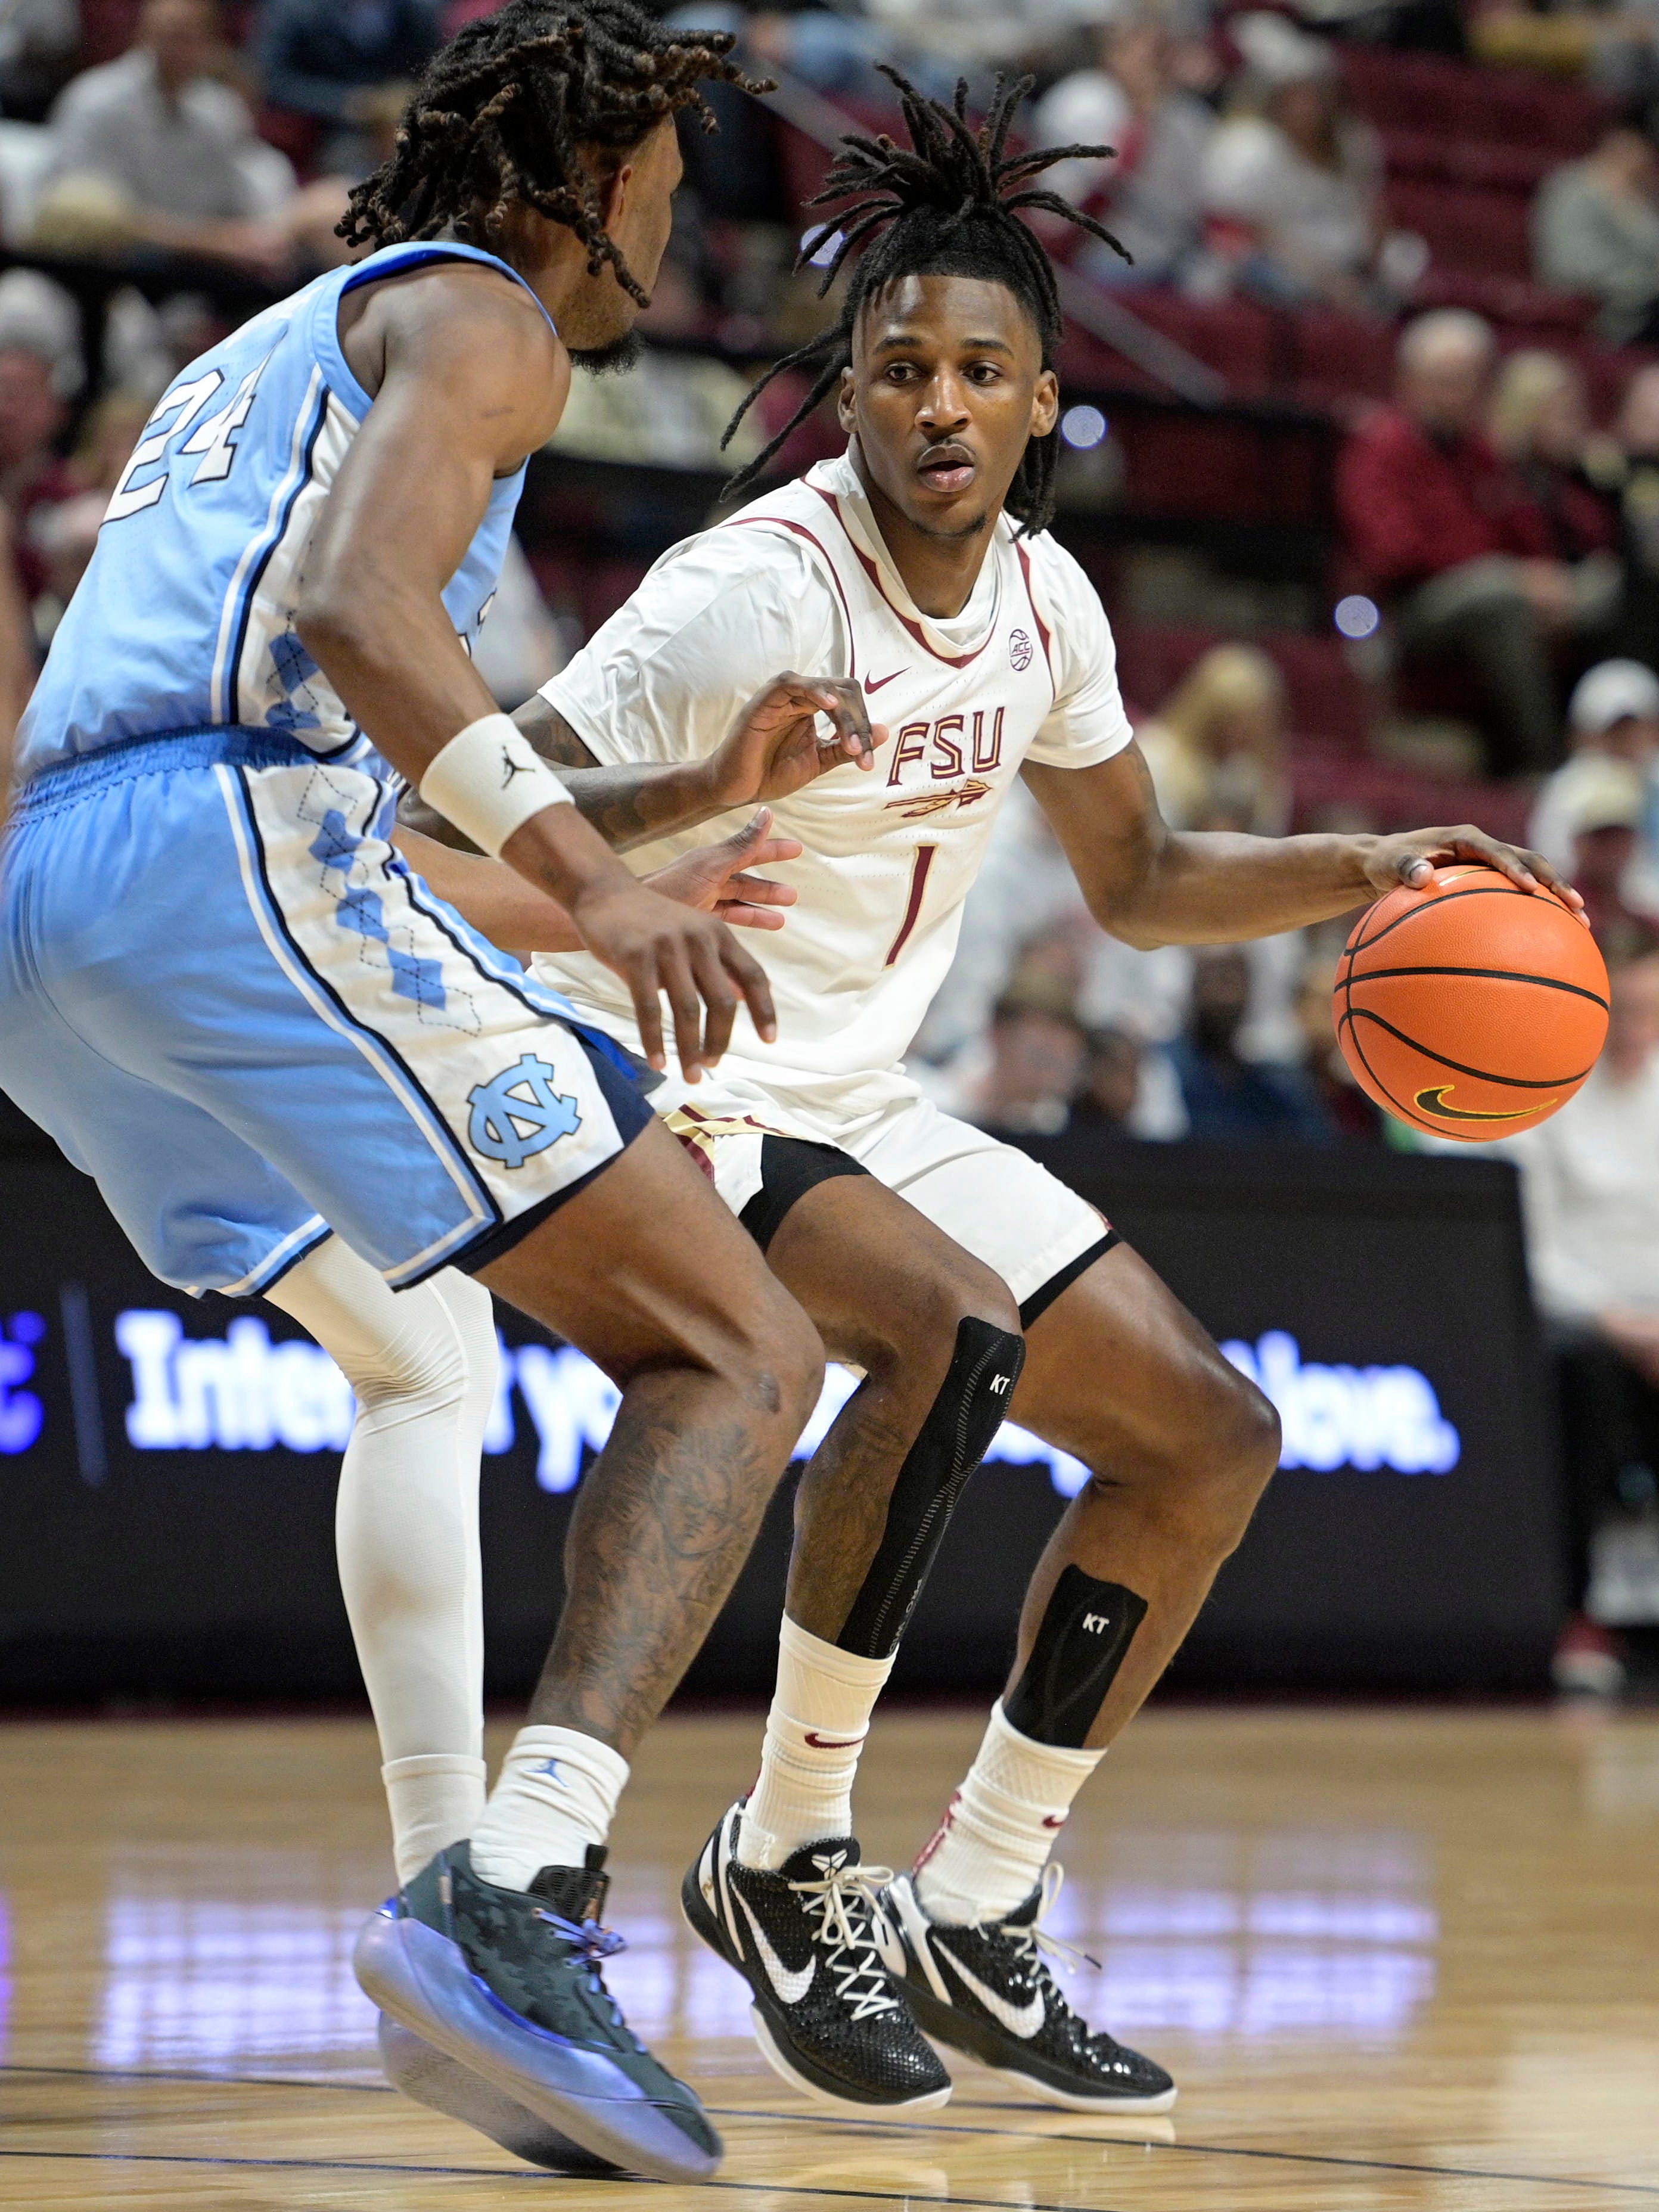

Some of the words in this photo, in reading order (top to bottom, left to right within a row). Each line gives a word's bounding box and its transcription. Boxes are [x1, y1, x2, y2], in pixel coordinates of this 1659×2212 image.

[100, 365, 259, 528] 24
[1011, 641, 1030, 655] ACC
[886, 706, 1005, 787] FSU
[881, 842, 940, 971] 1
[989, 1374, 1011, 1395] KT
[1082, 1613, 1110, 1635] KT
